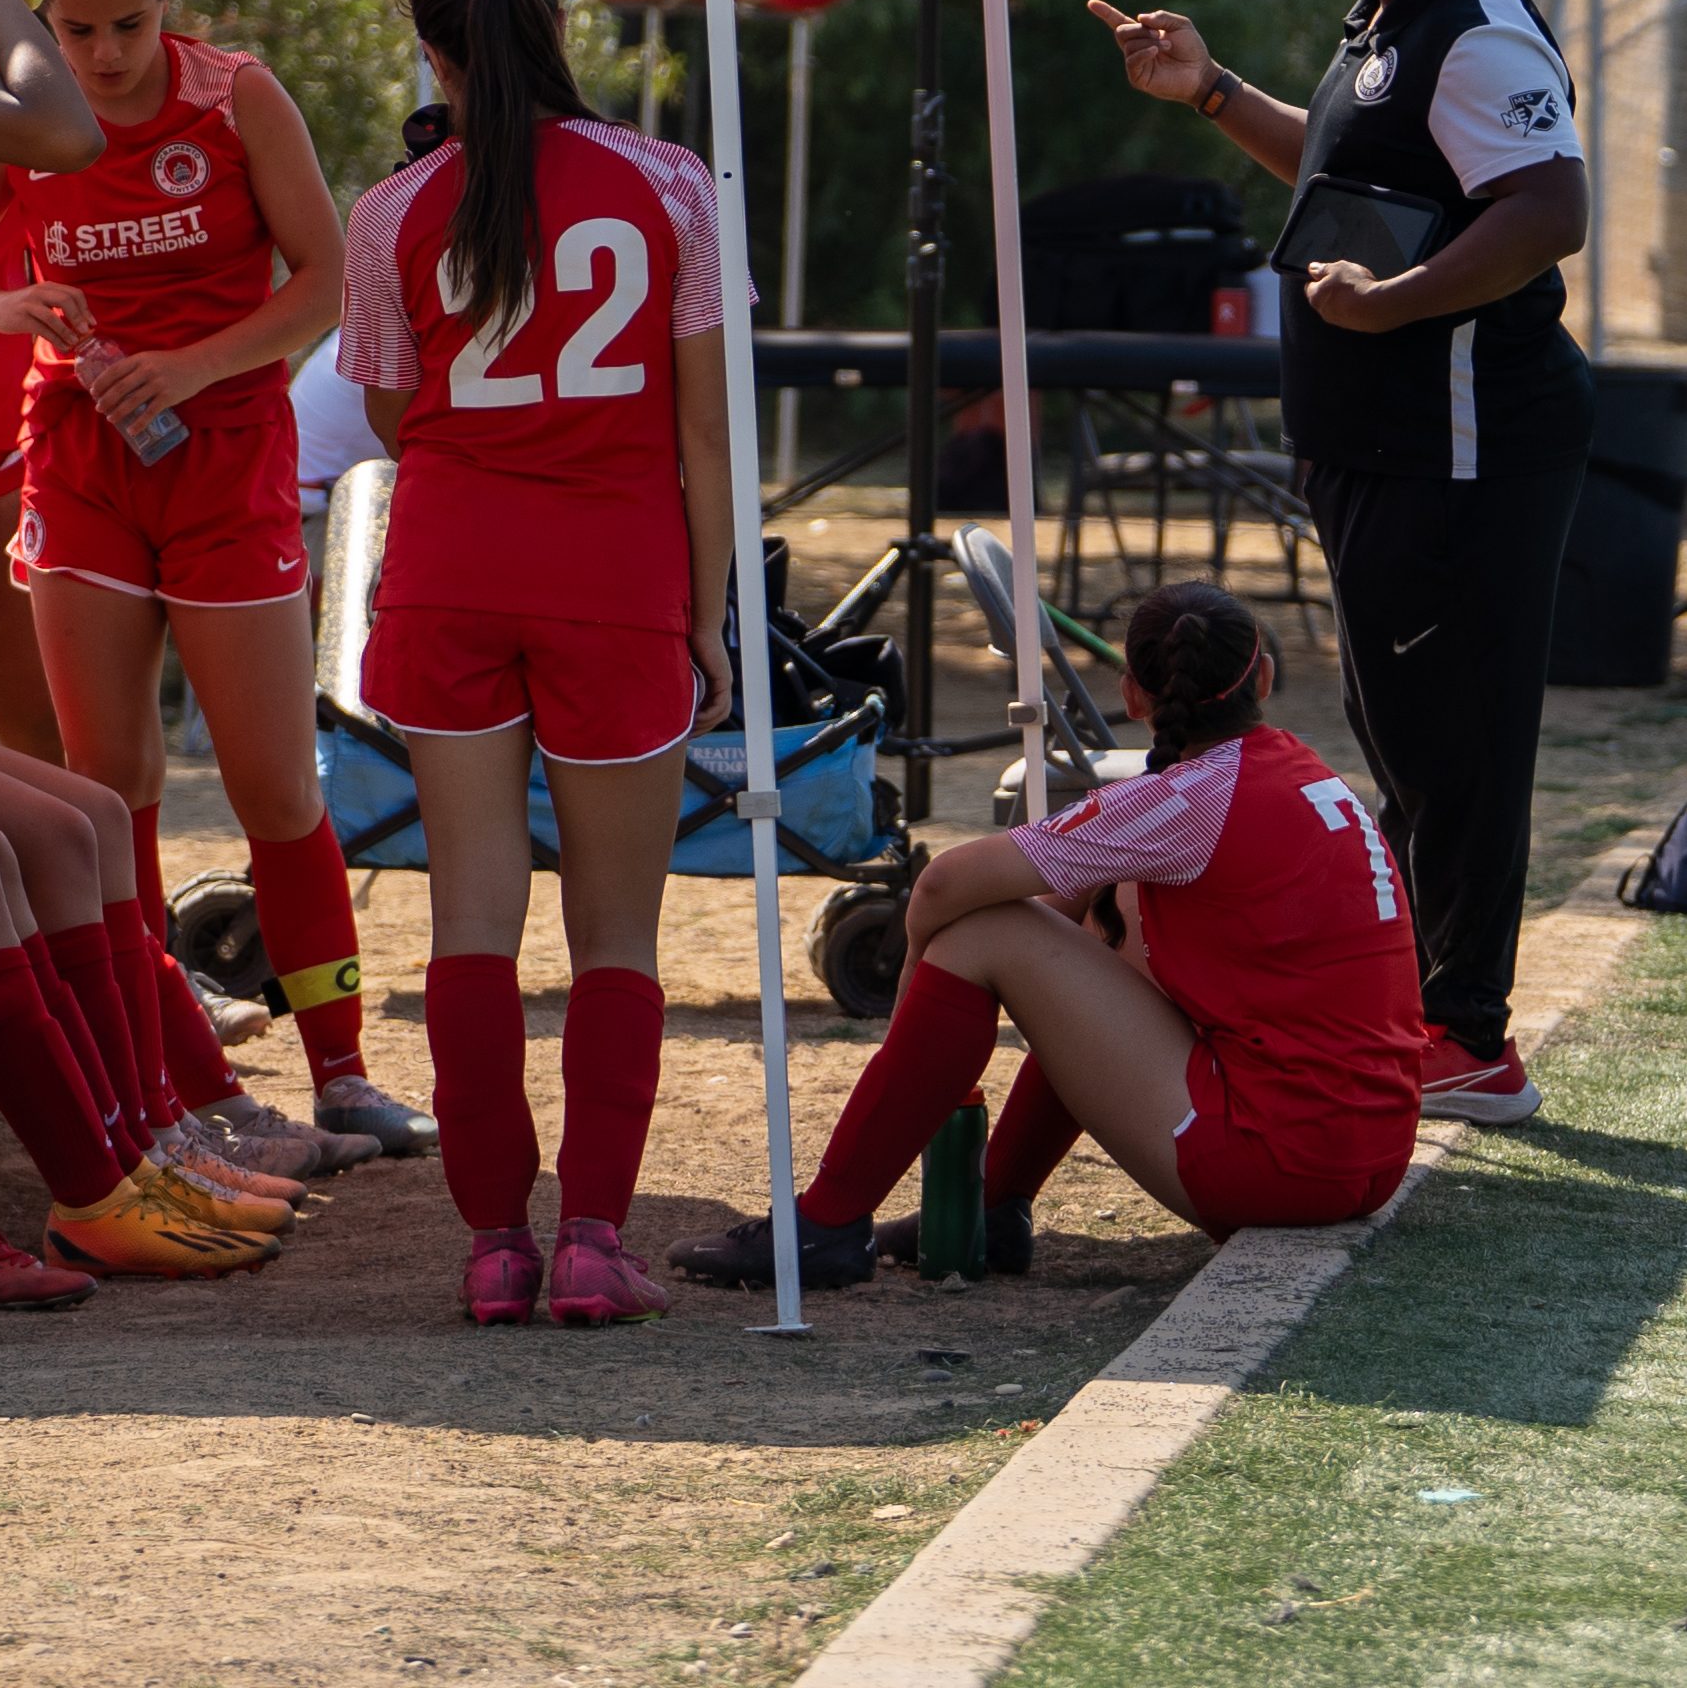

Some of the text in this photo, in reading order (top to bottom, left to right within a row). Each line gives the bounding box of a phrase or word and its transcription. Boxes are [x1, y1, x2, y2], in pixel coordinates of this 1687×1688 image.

[1513, 94, 1534, 105] MLS
[156, 145, 201, 170] SACRAMENTO
[169, 178, 201, 193] UNITED
[75, 205, 202, 250] STREET
[78, 230, 209, 263] HOME LENDING
[436, 217, 650, 408] 22
[692, 747, 747, 761] REATIV
[1300, 776, 1398, 921] 7
[335, 960, 360, 992] C
